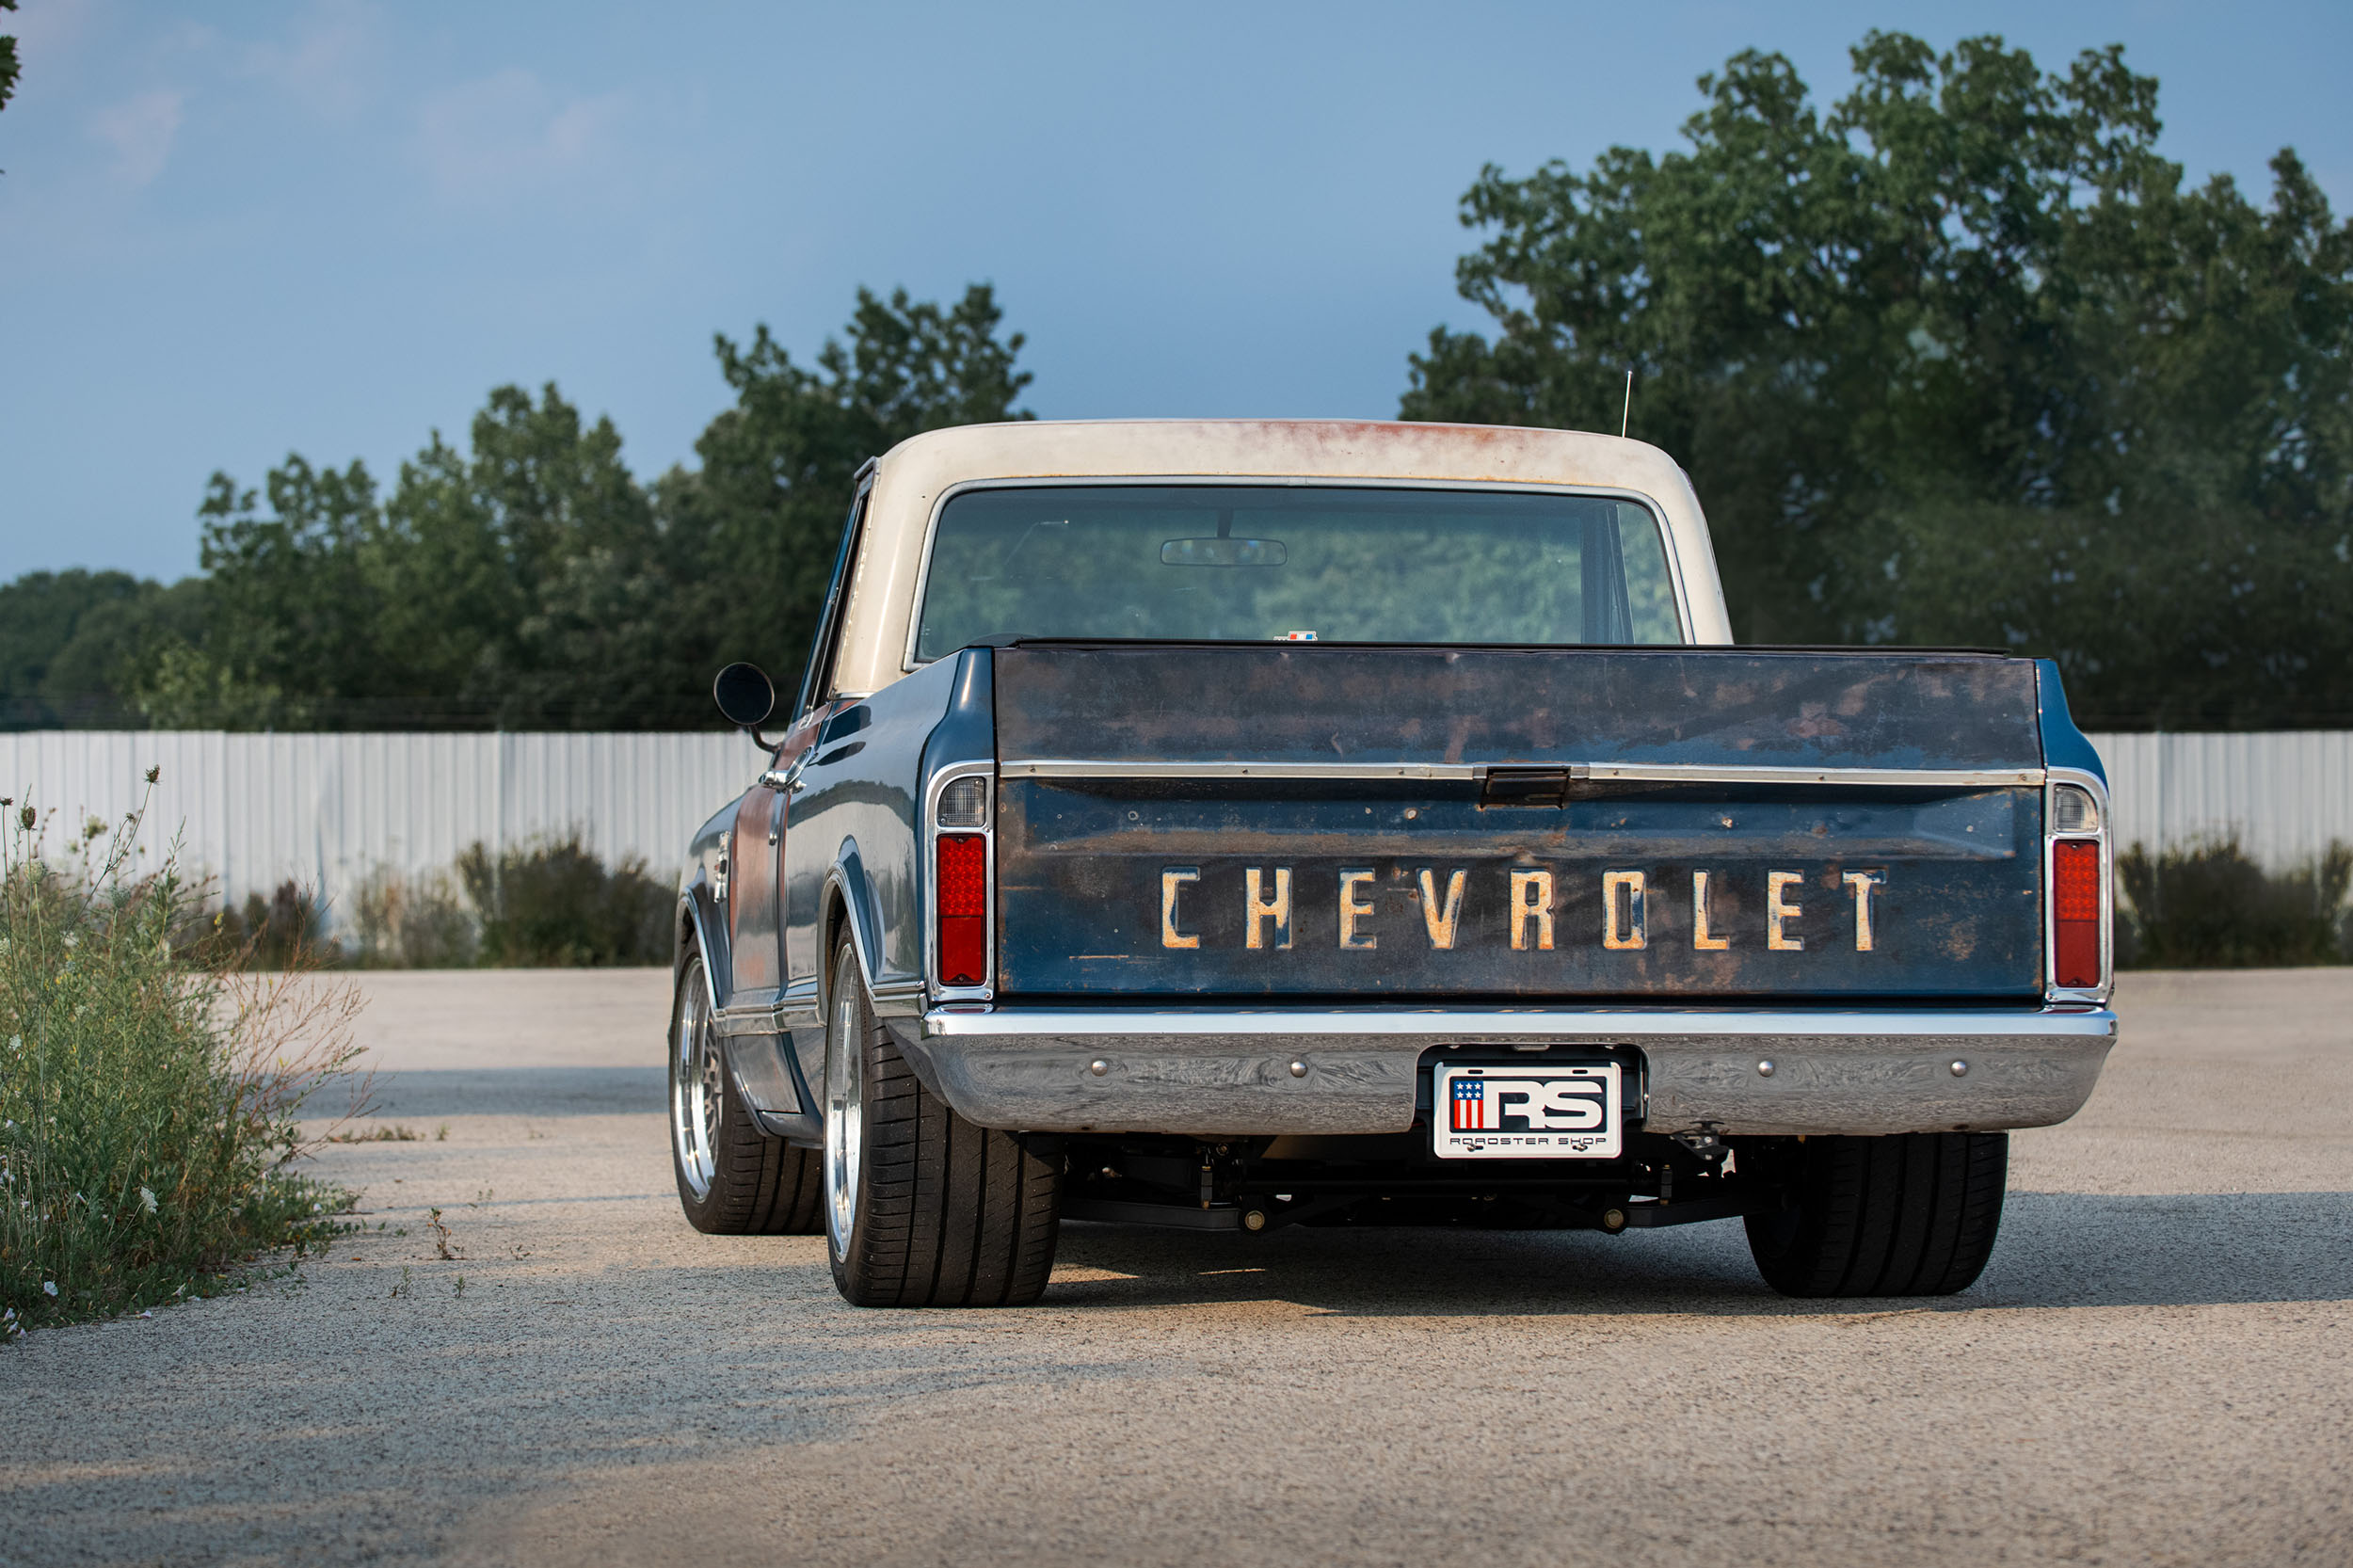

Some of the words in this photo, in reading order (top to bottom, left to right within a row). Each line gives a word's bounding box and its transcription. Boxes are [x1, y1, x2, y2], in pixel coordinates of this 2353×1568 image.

[1161, 866, 1887, 951] CHEVROLET
[1483, 1080, 1604, 1129] RS
[1449, 1137, 1549, 1145] ROADSTER
[1558, 1137, 1607, 1145] SHOP
